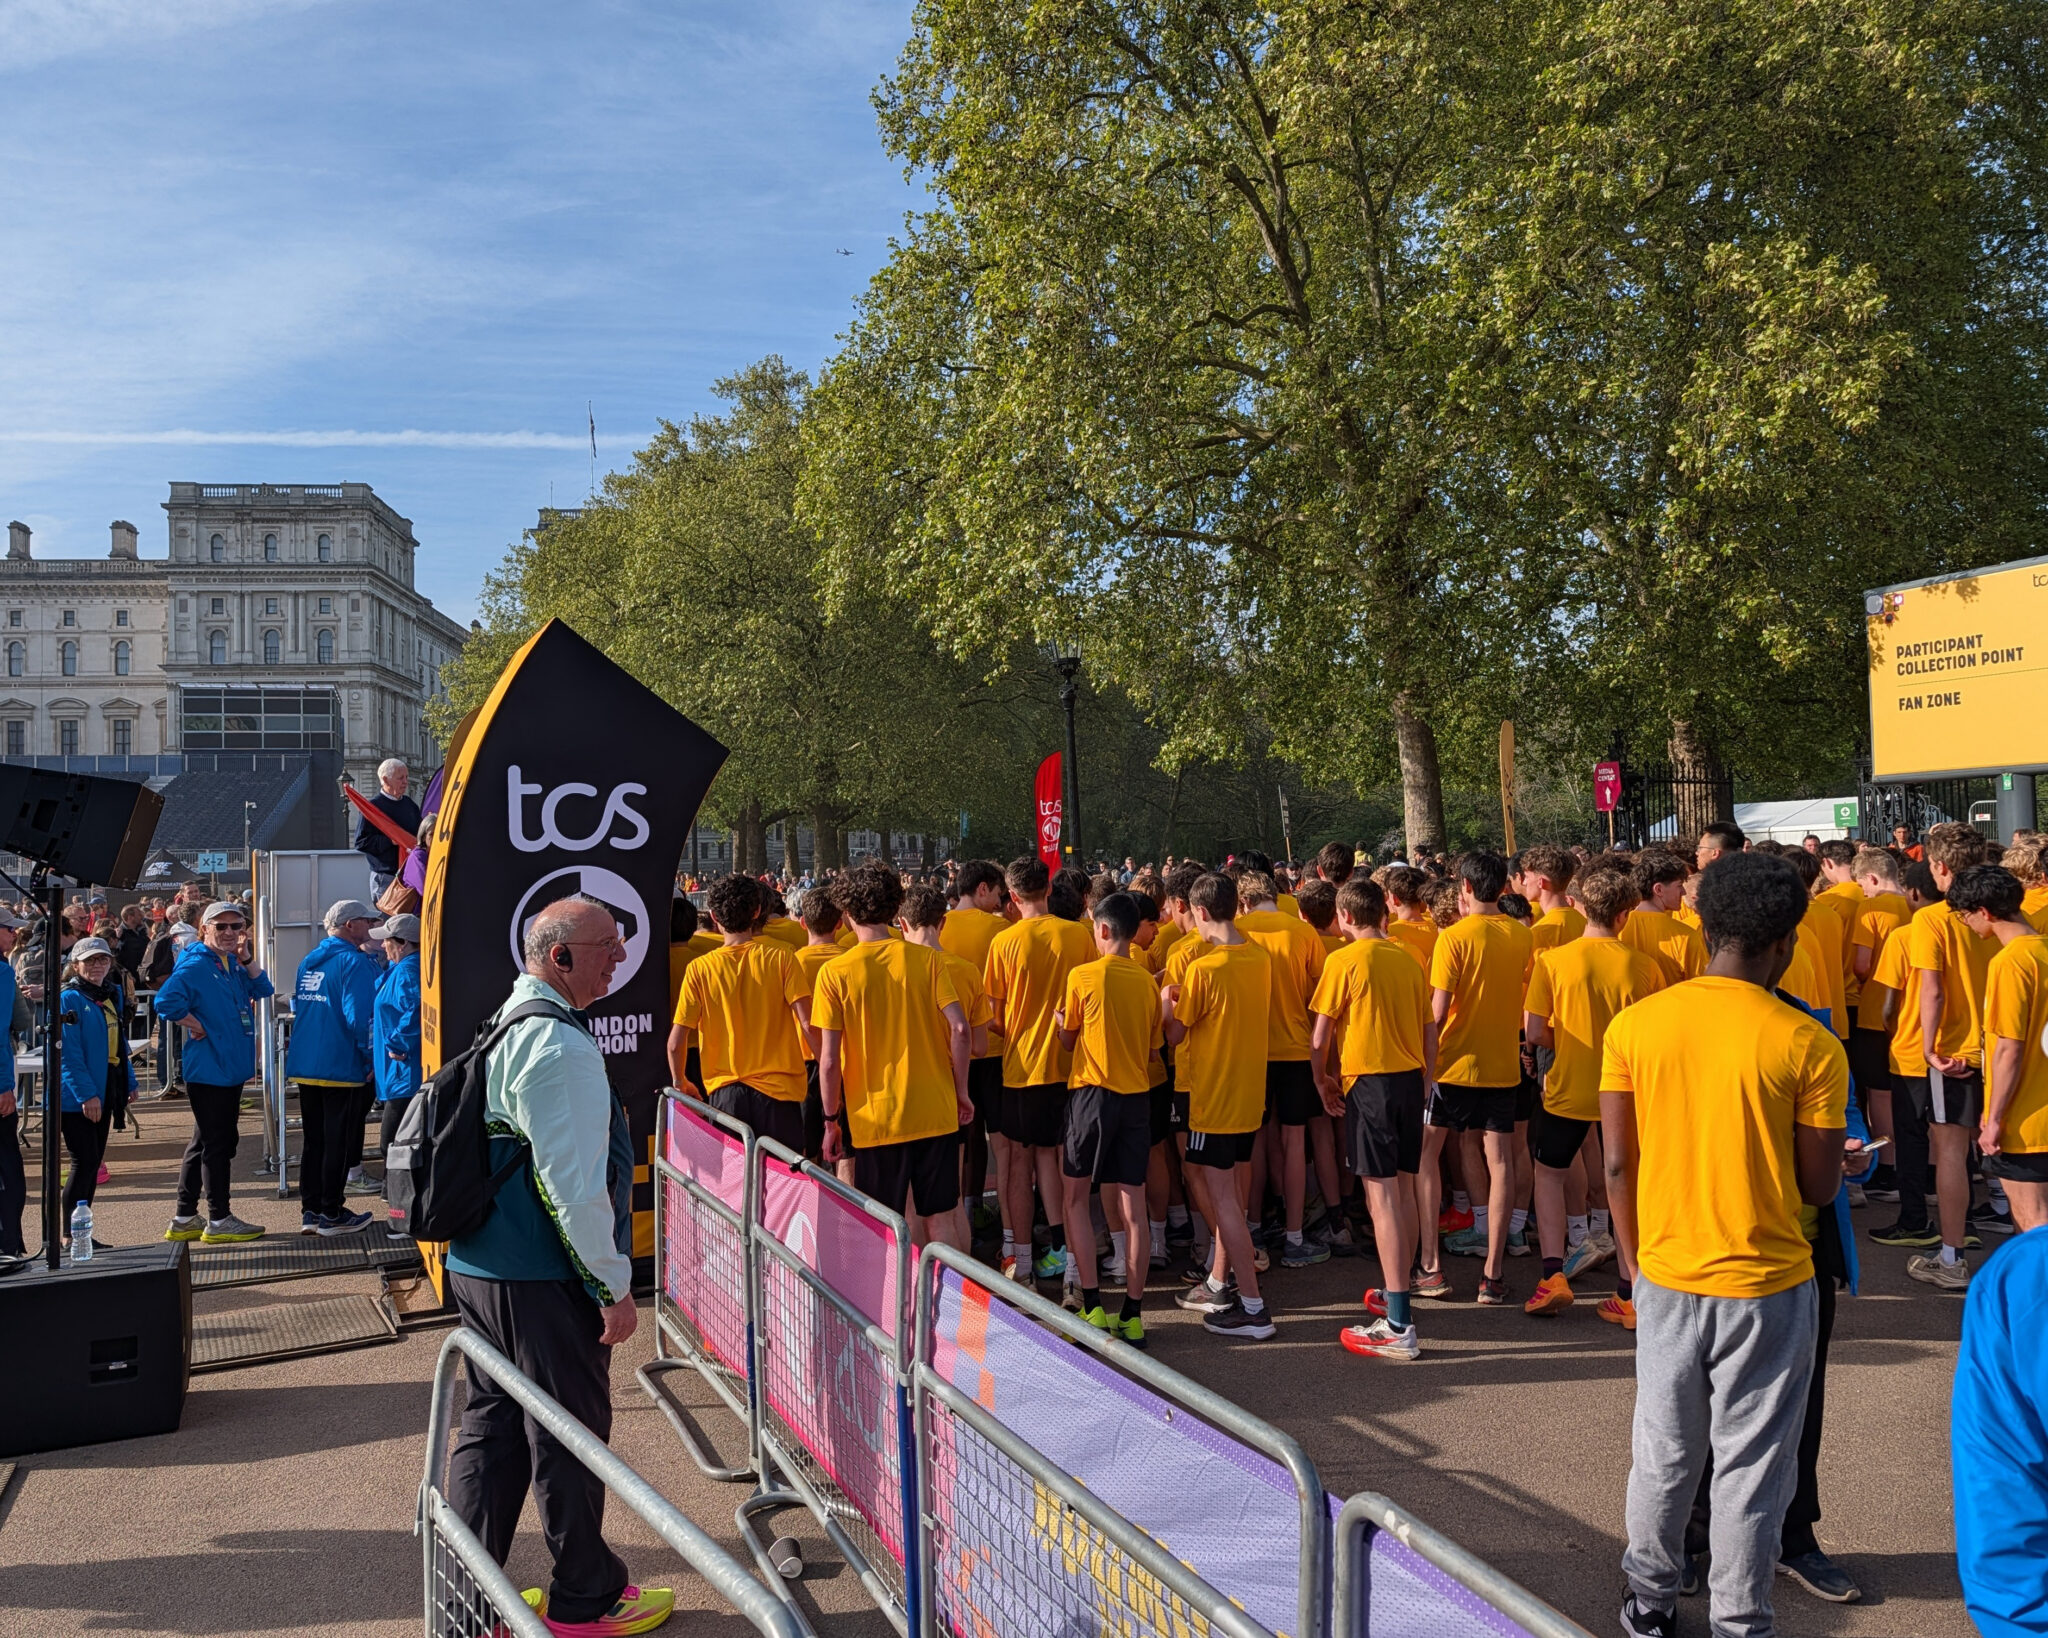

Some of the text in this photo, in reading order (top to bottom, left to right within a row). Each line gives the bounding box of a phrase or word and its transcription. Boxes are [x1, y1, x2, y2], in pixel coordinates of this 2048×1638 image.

[2033, 573, 2048, 587] tc
[1896, 634, 1983, 659] PARTICIPANT
[1897, 646, 2024, 676] COLLECTION POINT
[1899, 692, 1961, 711] FAN ZONE
[507, 764, 650, 852] tcs
[1040, 799, 1062, 815] tcs
